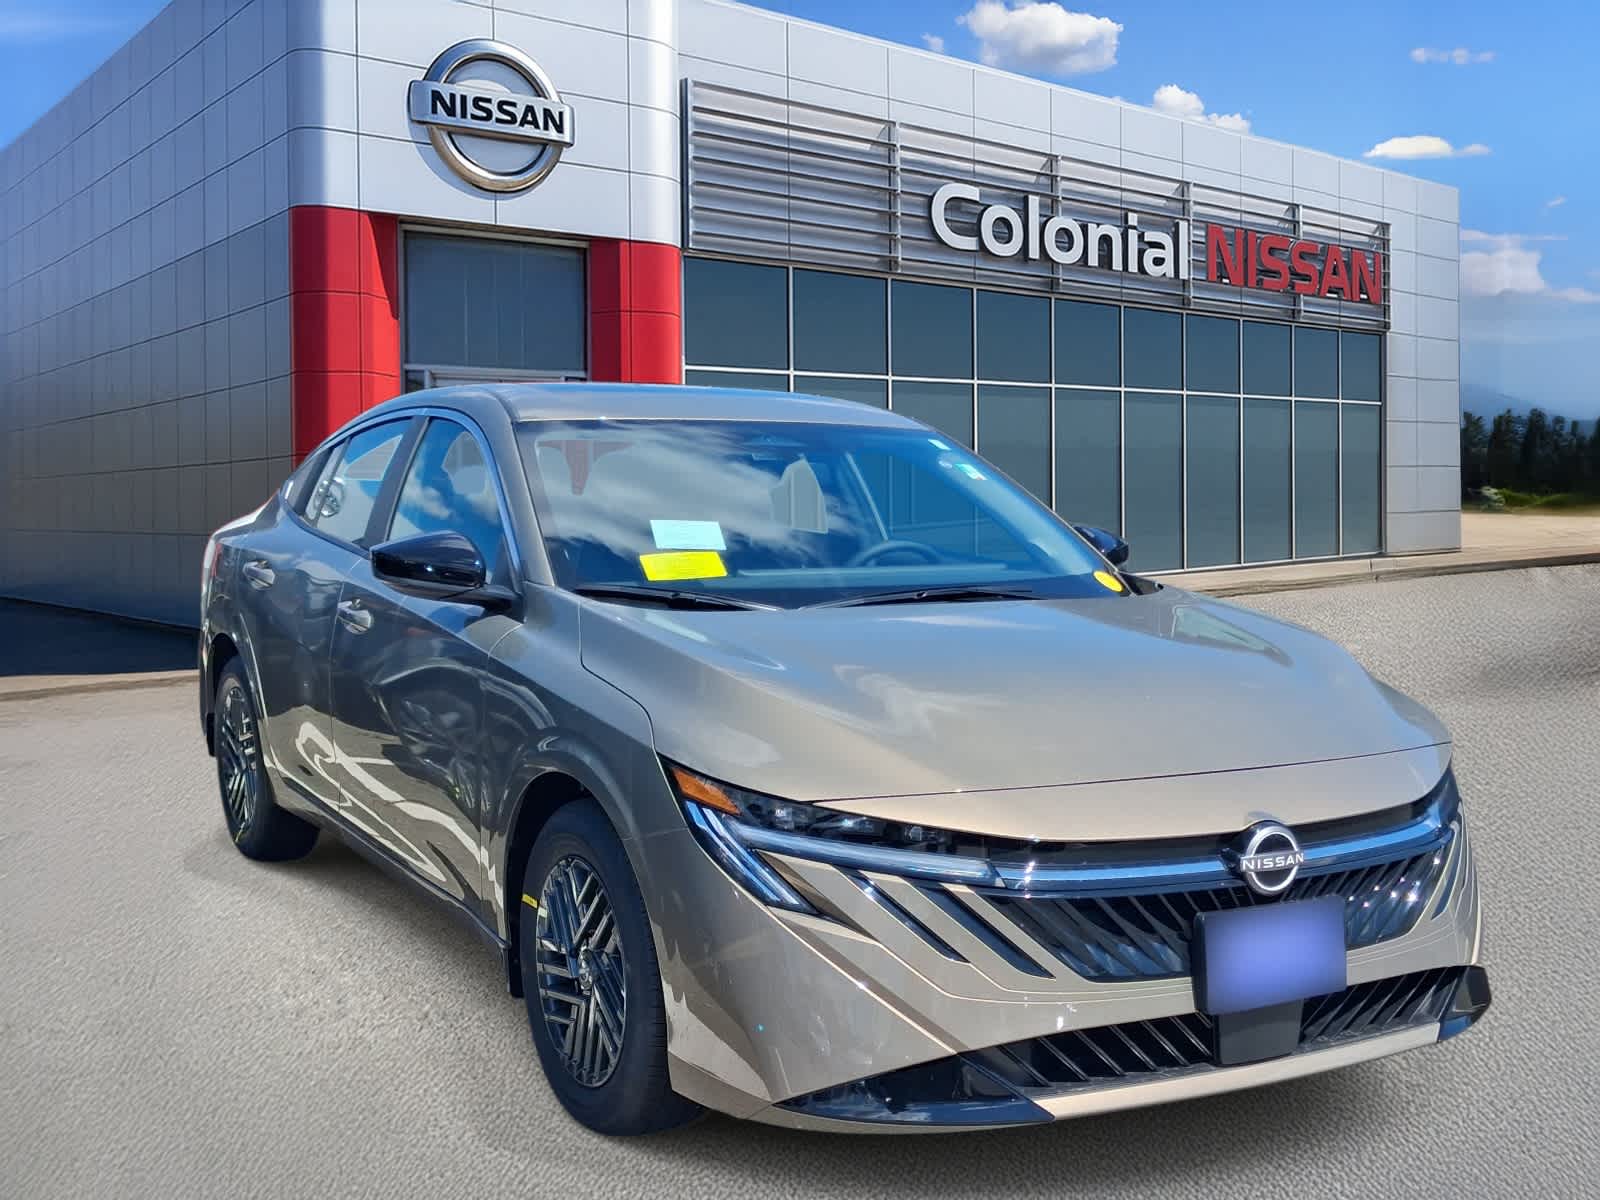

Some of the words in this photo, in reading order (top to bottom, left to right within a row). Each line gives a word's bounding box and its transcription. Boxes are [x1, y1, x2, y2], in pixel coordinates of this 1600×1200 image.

[430, 89, 564, 134] NISSAN
[929, 182, 1189, 280] Colonial
[1206, 223, 1382, 305] NISSAN
[1242, 852, 1304, 870] NISSAN
